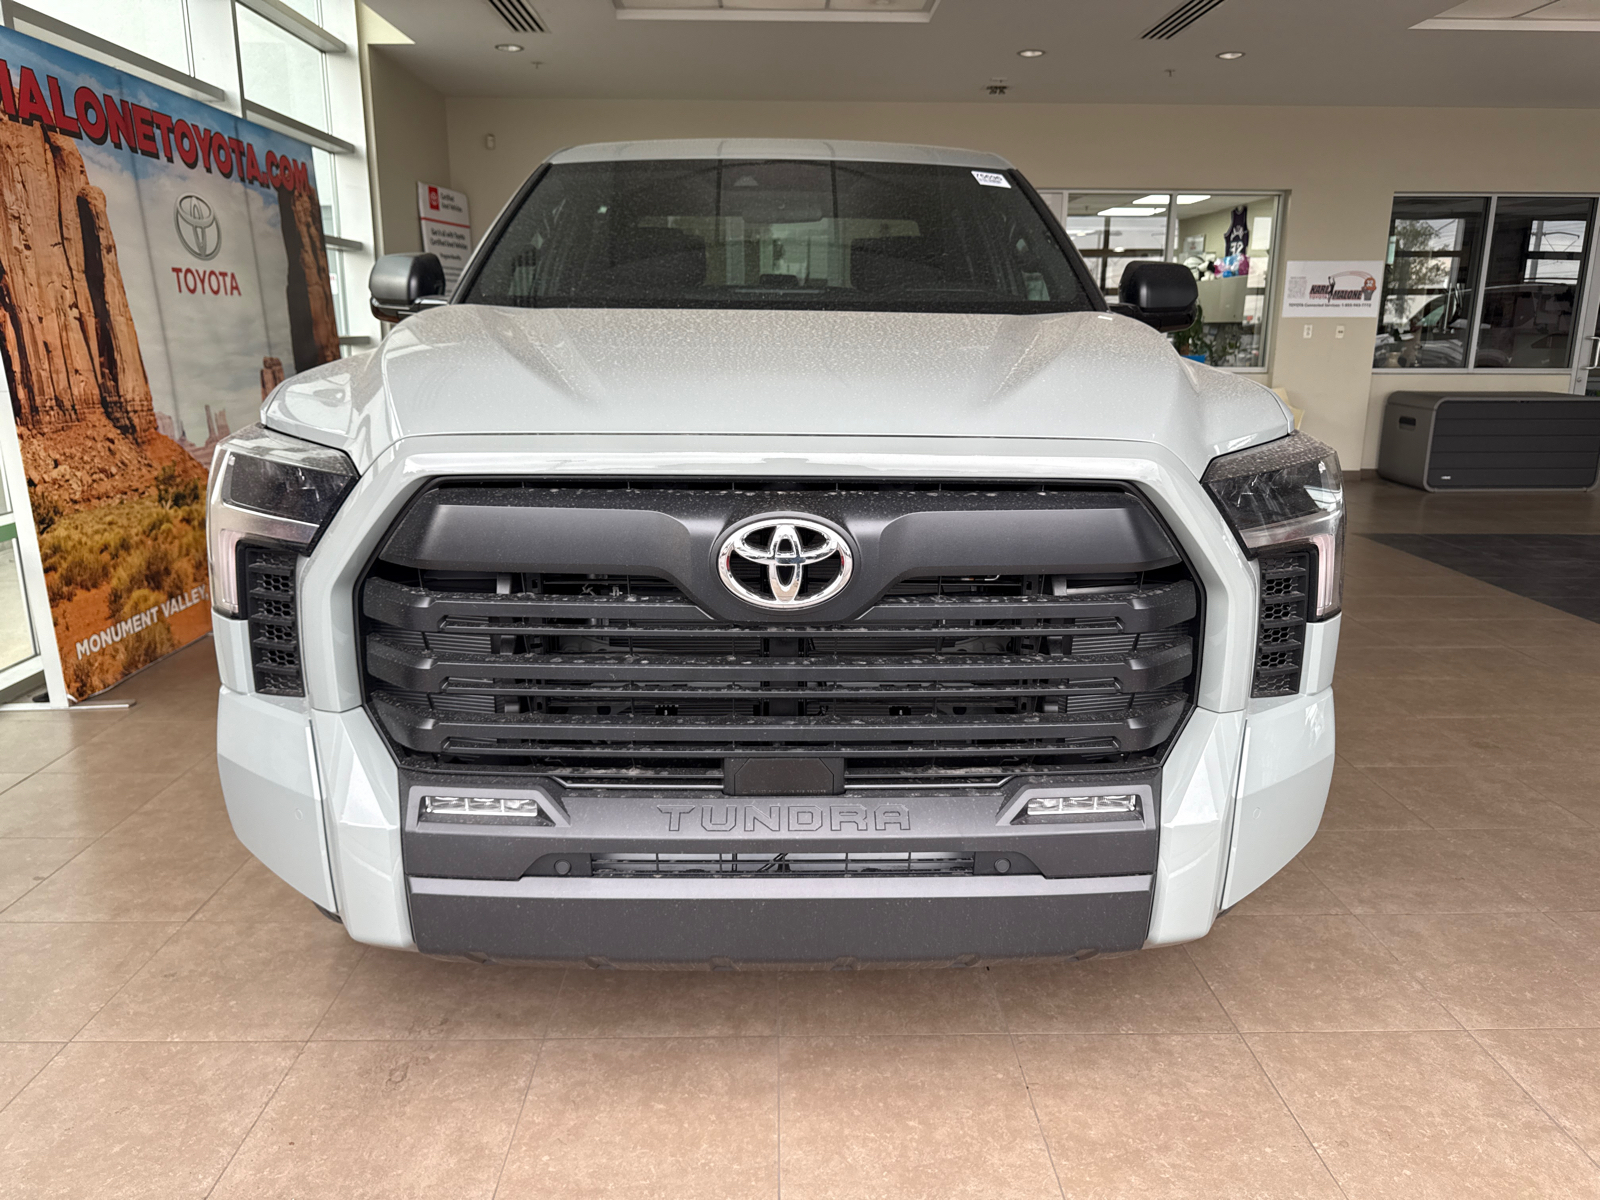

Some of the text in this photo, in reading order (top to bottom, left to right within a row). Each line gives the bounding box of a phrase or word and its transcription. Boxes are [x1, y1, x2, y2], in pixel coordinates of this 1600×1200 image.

[172, 266, 242, 296] TOYOTA
[1310, 285, 1330, 294] KARL
[1332, 289, 1363, 300] MALONE
[75, 584, 209, 660] MONUMENT VALLEY,
[656, 804, 911, 831] TUNDRA
